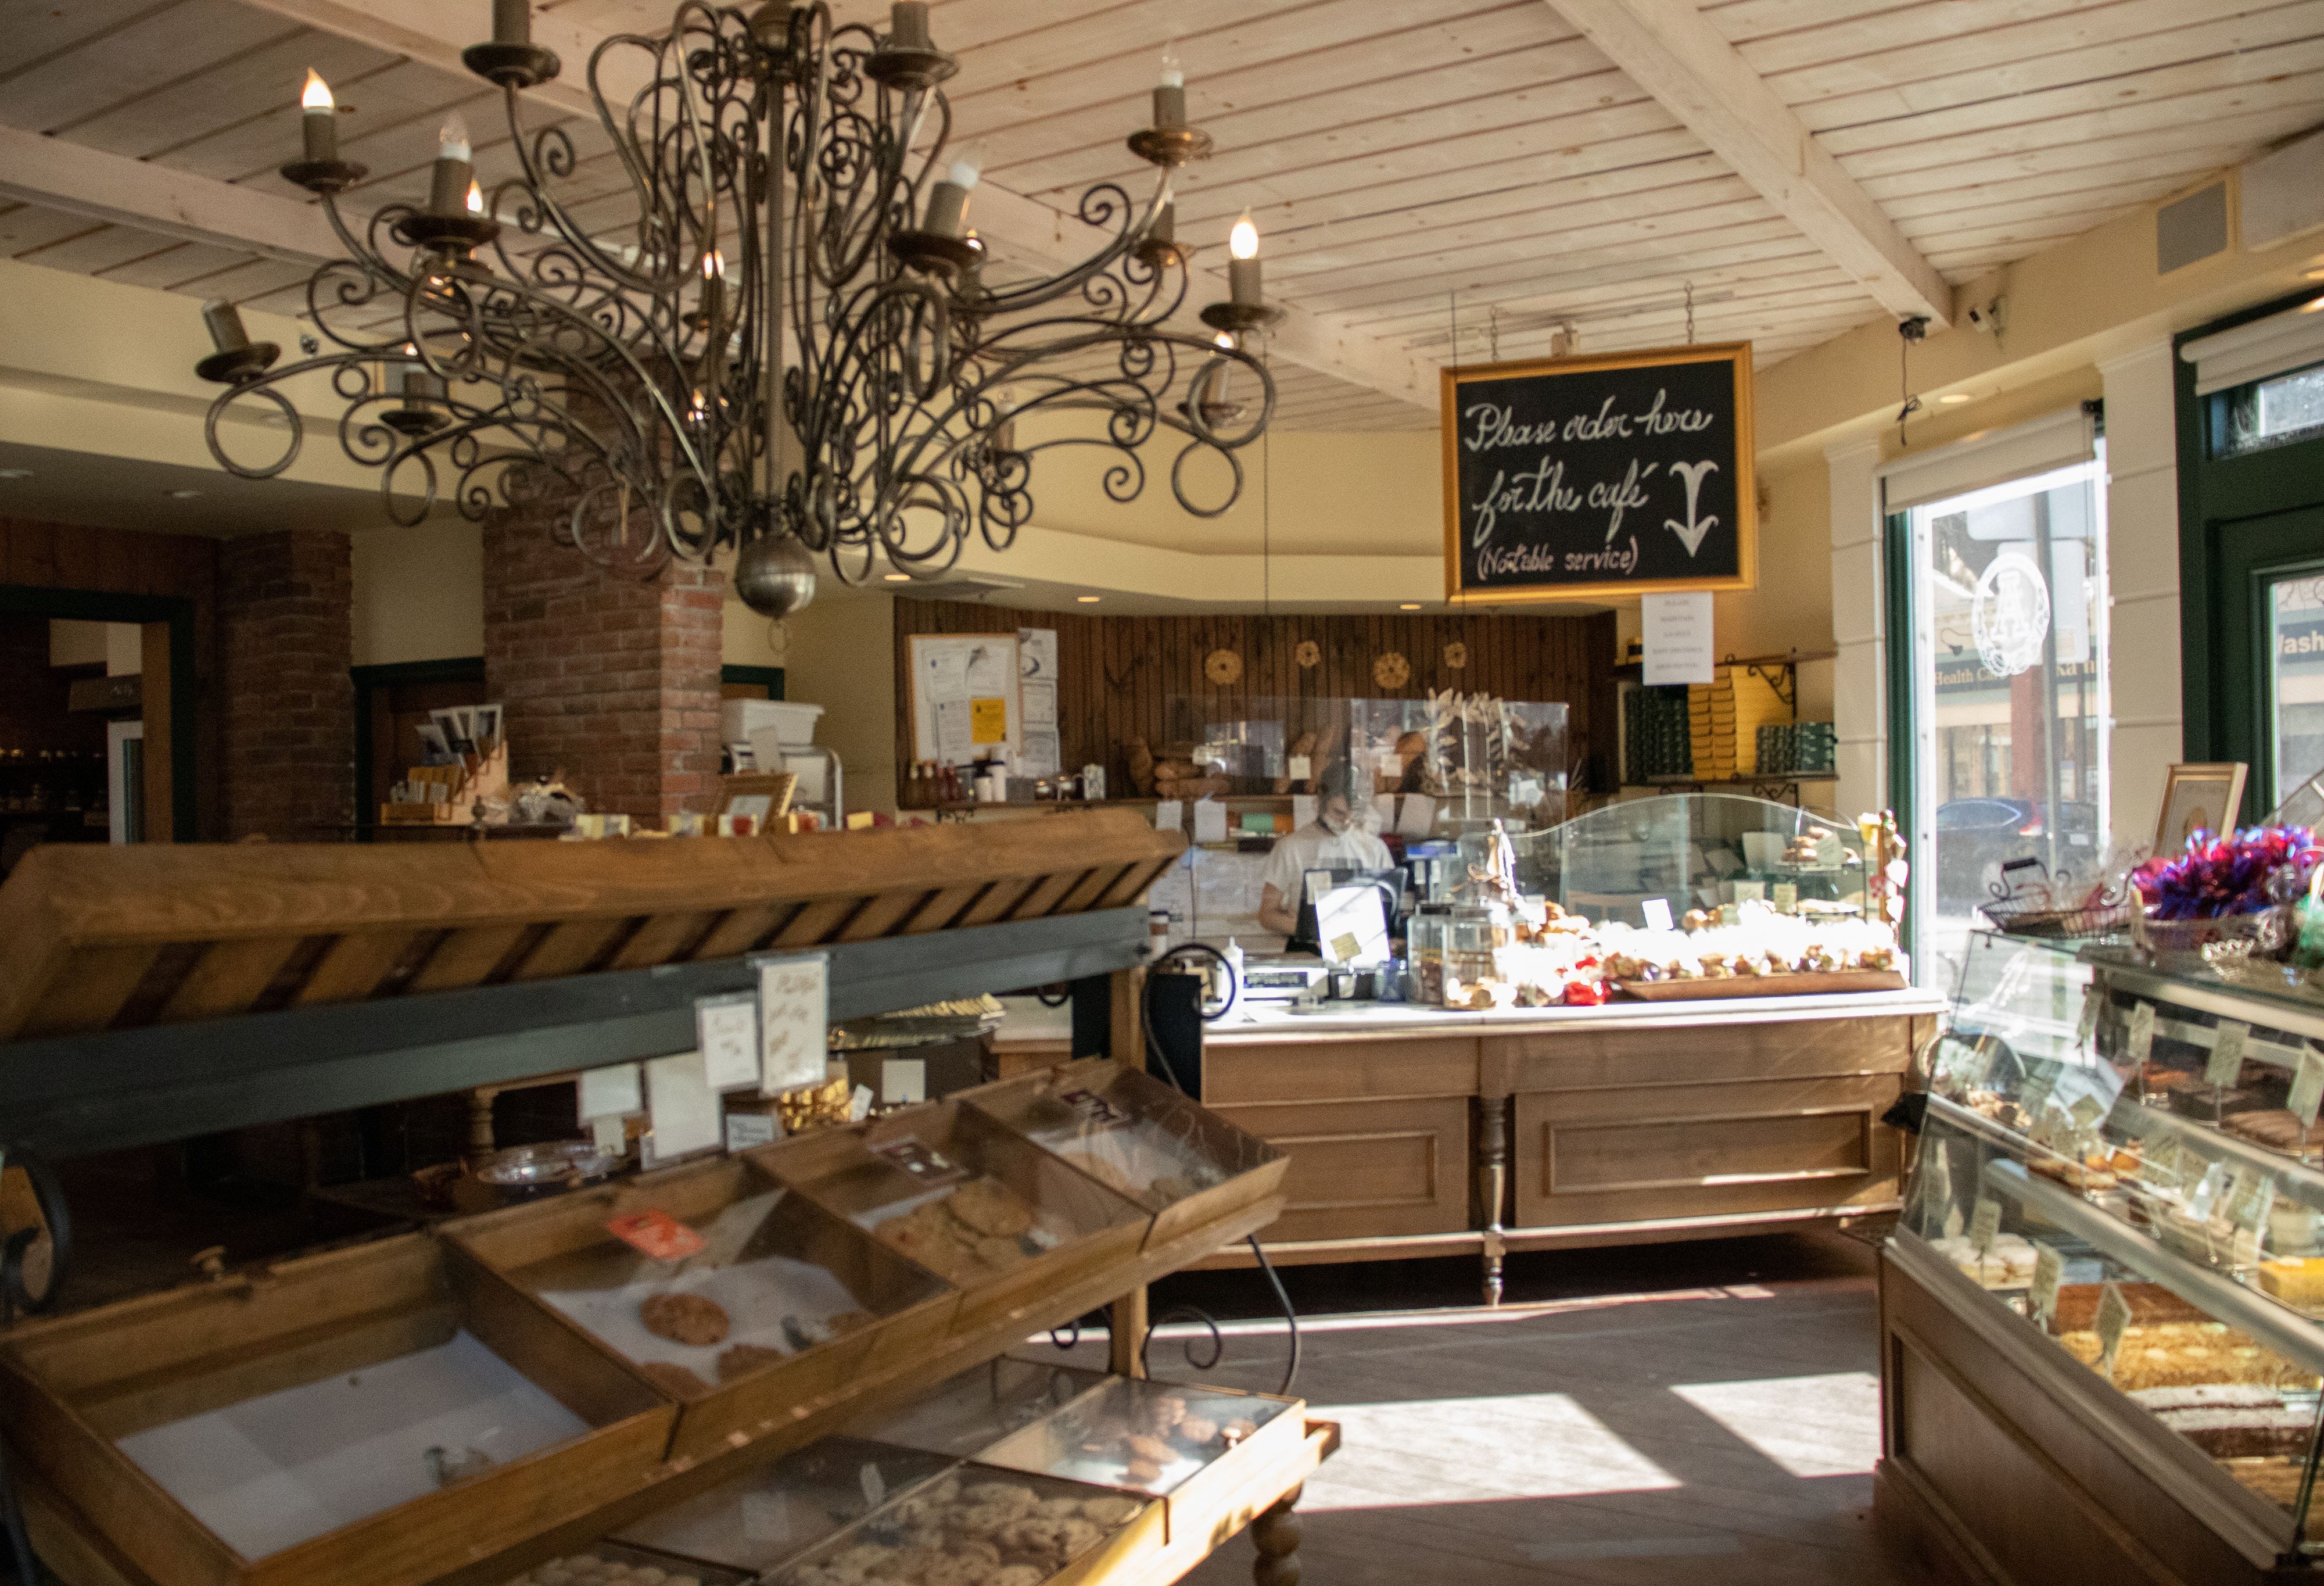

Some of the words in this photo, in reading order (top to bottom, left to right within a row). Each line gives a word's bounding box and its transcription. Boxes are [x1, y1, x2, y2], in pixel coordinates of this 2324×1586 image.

[1464, 402, 1558, 452] Please
[1562, 394, 1634, 443] order
[1633, 387, 1715, 437] here
[1588, 457, 1660, 543] café
[1564, 534, 1639, 577] service)
[1935, 668, 1974, 685] Health
